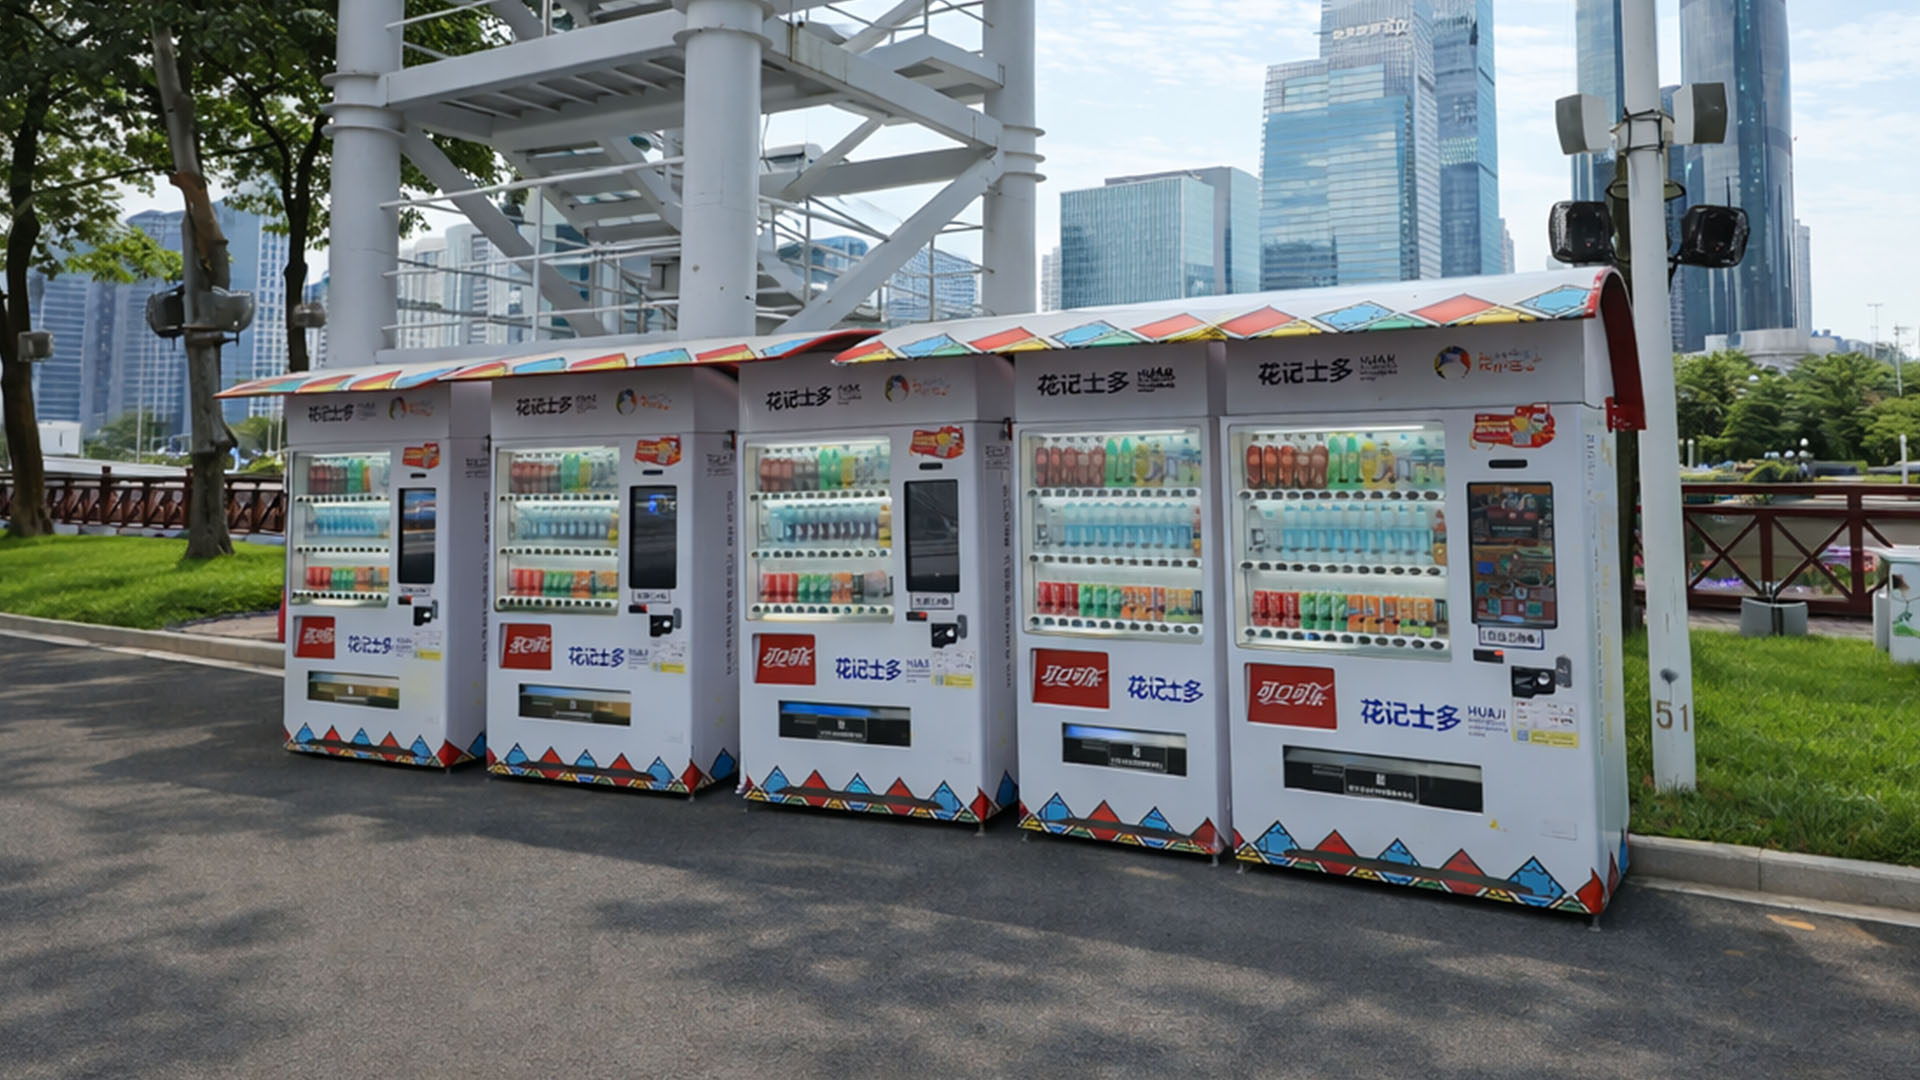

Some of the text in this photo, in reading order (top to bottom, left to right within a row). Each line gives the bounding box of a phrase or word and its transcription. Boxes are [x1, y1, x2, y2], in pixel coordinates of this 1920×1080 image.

[1037, 370, 1130, 396] 花记士多
[1259, 357, 1353, 386] 花记士多
[766, 385, 832, 412] 花记士多
[835, 657, 902, 681] 花记士多
[1127, 674, 1204, 704] 花记士多
[1360, 698, 1462, 731] 花记士多
[1467, 705, 1507, 720] HUAJI
[1656, 699, 1689, 733] 51
